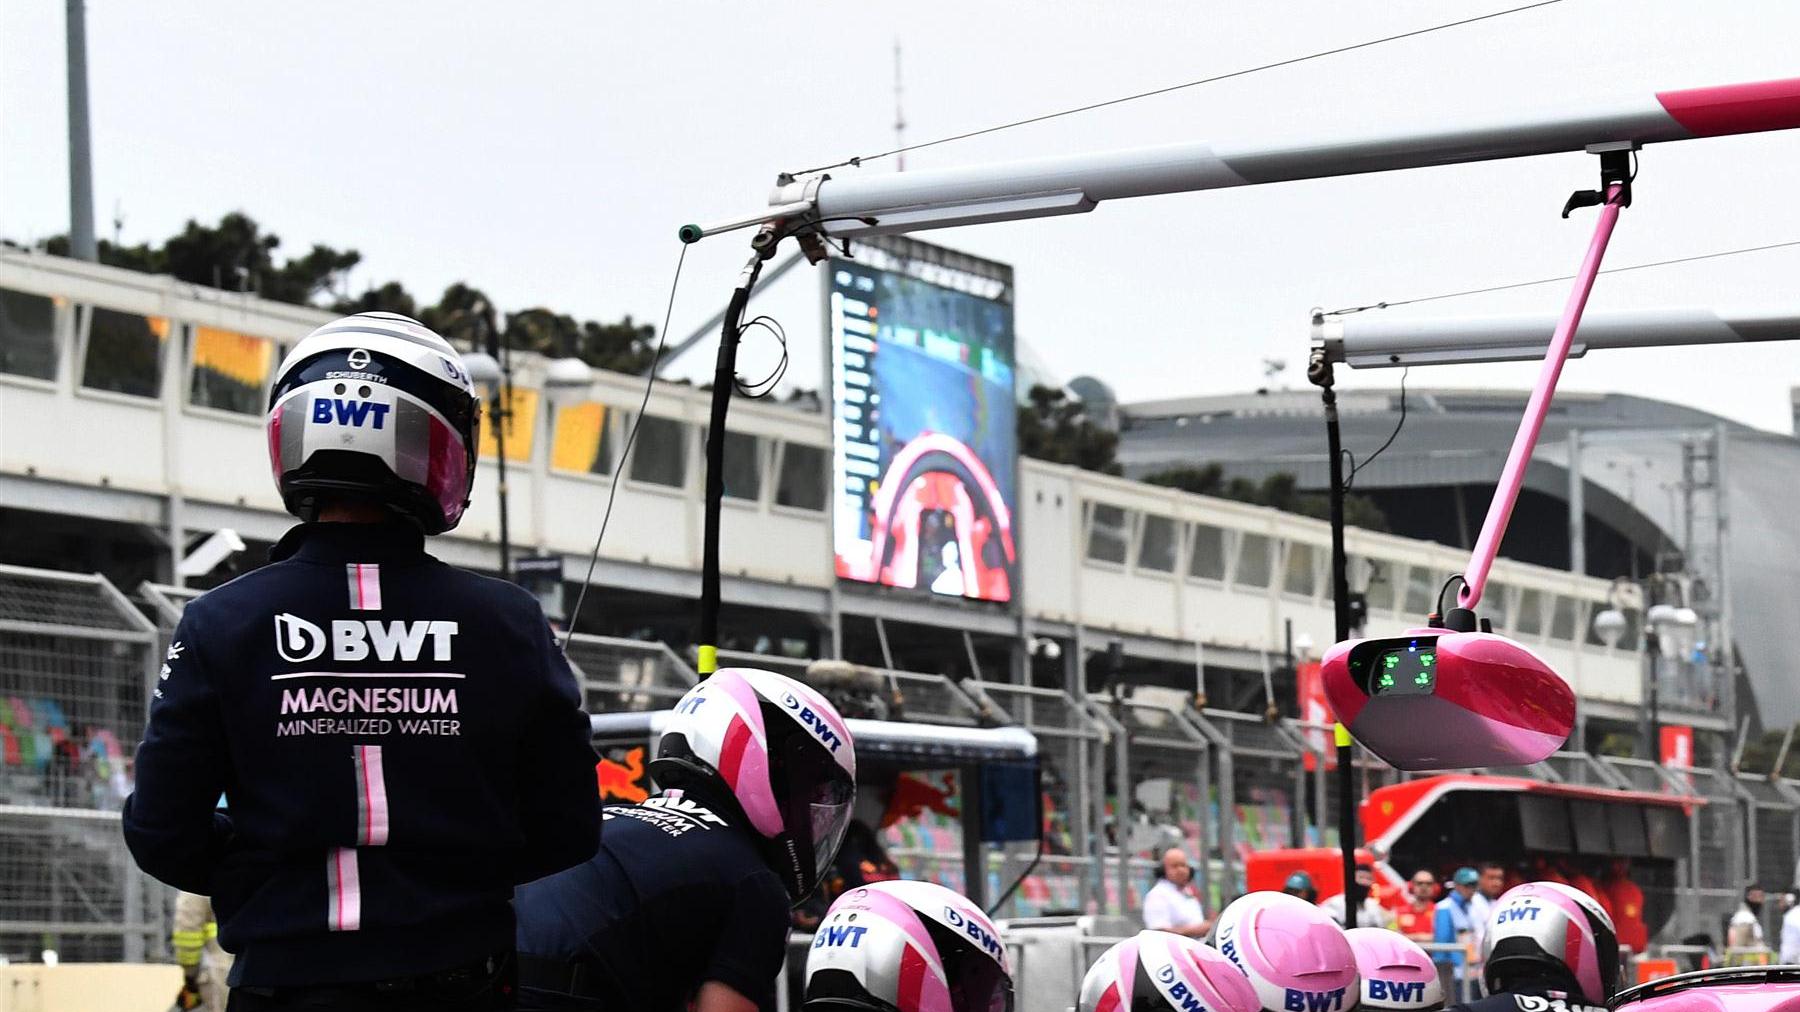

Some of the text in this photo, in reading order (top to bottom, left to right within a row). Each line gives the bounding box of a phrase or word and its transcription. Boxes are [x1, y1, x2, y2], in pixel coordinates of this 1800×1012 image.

[326, 371, 388, 384] SCHUBERTH
[313, 398, 390, 430] BWT
[332, 620, 458, 661] BWT
[281, 688, 458, 714] MAGNESIUM
[679, 696, 706, 715] WT
[277, 719, 461, 737] MINERALIZED WATER
[799, 707, 842, 753] BWT
[1497, 907, 1542, 924] BWT
[813, 926, 868, 949] BWT
[1368, 979, 1426, 1003] BWT
